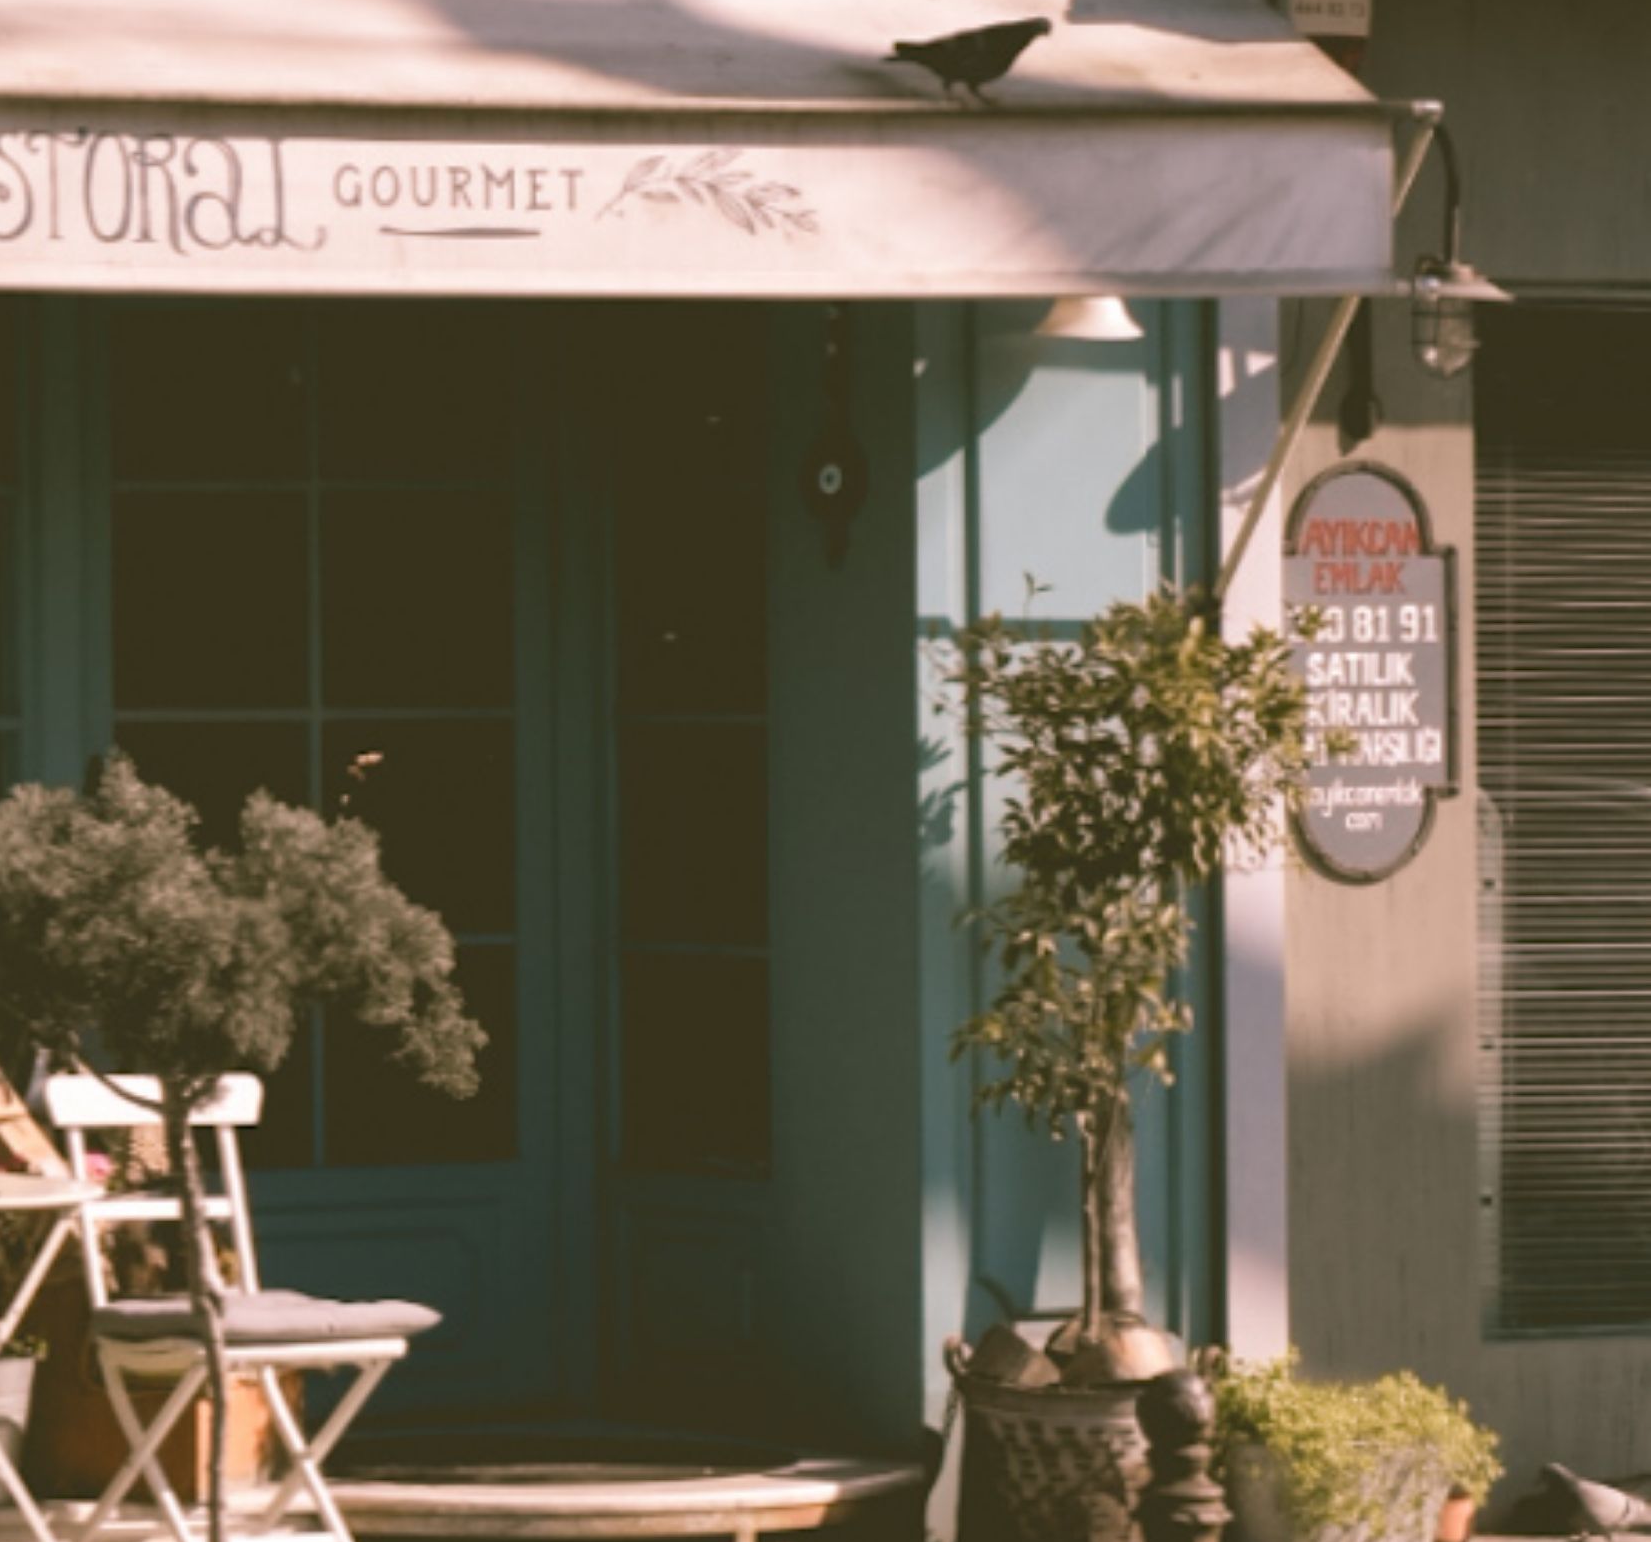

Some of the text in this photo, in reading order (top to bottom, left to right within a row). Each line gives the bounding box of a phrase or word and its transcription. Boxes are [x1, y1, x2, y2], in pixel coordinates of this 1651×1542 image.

[333, 162, 585, 211] GOURMET
[1313, 561, 1406, 596] EMLAK
[1352, 604, 1391, 644] 81
[1399, 604, 1438, 644] 91
[1305, 651, 1416, 687] SATILIK
